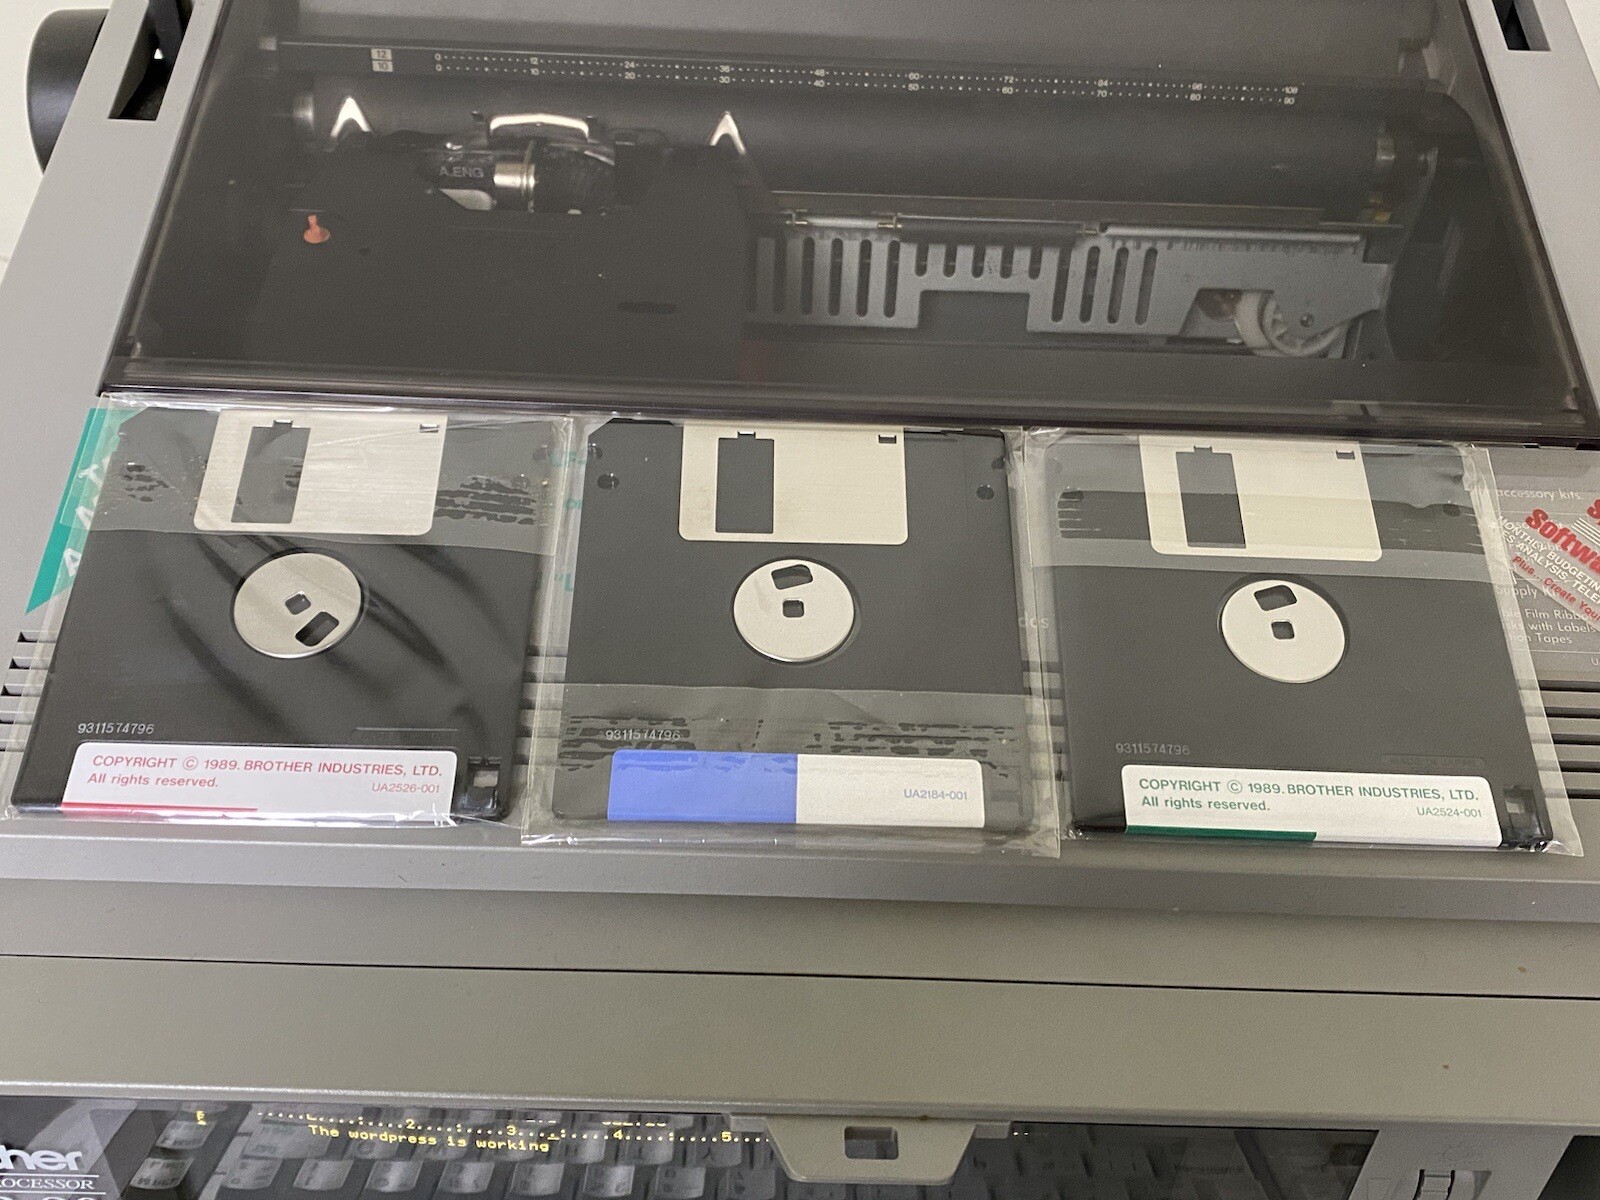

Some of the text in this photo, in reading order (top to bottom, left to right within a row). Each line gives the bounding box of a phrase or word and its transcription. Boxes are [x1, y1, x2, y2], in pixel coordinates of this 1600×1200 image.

[530, 57, 539, 65] 12
[624, 61, 636, 69] 24
[814, 69, 826, 77] 48
[624, 72, 636, 80] 20
[719, 76, 731, 84] 30
[1497, 489, 1555, 501] accessory
[1499, 515, 1600, 592] MONTHLY BUDGETIN
[1543, 577, 1577, 603] Create
[1524, 608, 1550, 620] Film
[1527, 621, 1553, 632] with
[1556, 621, 1597, 633] Labels
[1534, 632, 1573, 645] Tapes
[76, 722, 156, 735] 9311574796
[605, 729, 681, 741] 9311574796
[1115, 742, 1191, 755] 9311574796
[92, 755, 178, 770] COPYRIGHT
[203, 758, 242, 771] 1989.
[243, 759, 313, 773] BROTHER
[317, 762, 407, 778] INDUSTRIES,
[412, 764, 443, 777] LTD.
[86, 772, 219, 788] All rights reserved.
[371, 782, 441, 794] UA2526-001
[903, 788, 968, 801] UA2184-001
[1138, 778, 1222, 793] COPYRIGHT
[1248, 782, 1285, 795] 1989.
[1287, 783, 1354, 797] BROTHER
[1358, 786, 1445, 802] INDUSTRIES,
[1449, 789, 1479, 801] LTD.
[1141, 796, 1271, 812] All rights reserved.
[1416, 806, 1483, 818] UA2524-001
[308, 1124, 340, 1138] The
[348, 1130, 438, 1145] wordpress
[447, 1133, 467, 1147] is
[476, 1138, 550, 1152] working
[0, 1177, 95, 1190] OCESSOR
